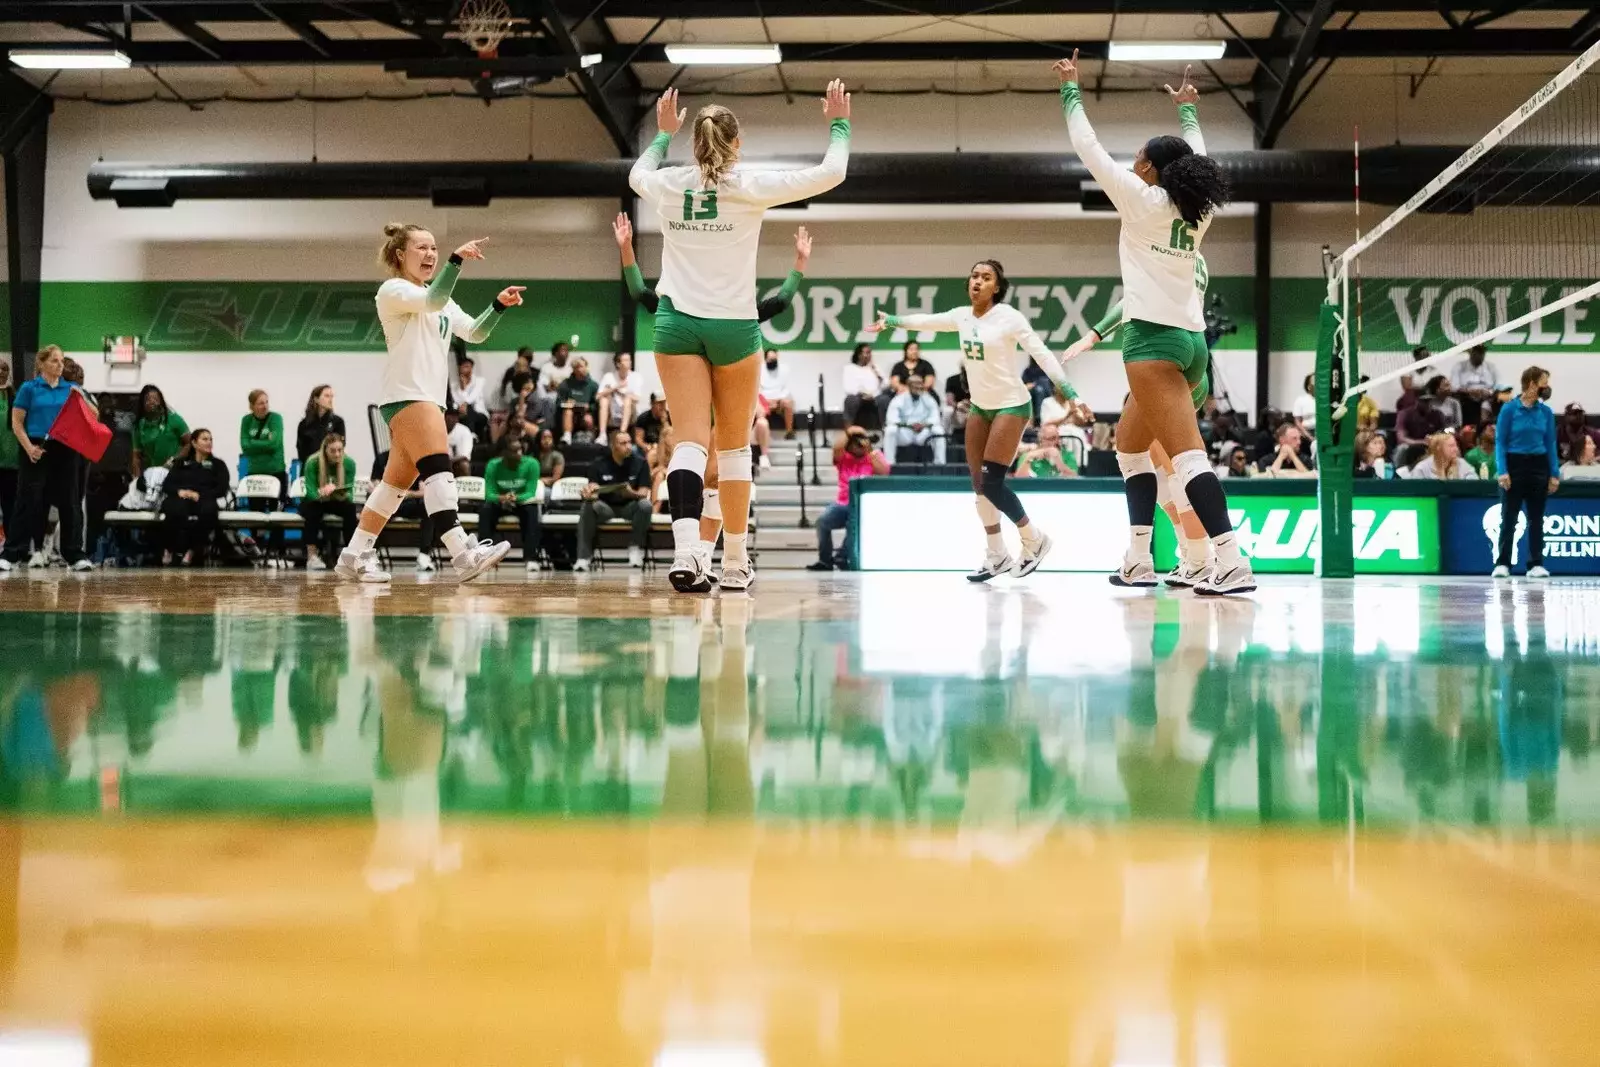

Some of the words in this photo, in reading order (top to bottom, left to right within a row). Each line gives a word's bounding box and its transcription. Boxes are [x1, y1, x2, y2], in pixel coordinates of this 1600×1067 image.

[683, 189, 718, 221] 13
[702, 223, 734, 231] TEXAS
[1170, 218, 1195, 251] 16
[757, 285, 939, 345] ORTH
[1003, 285, 1124, 343] EX
[1388, 286, 1600, 345] VOLLE
[963, 340, 985, 361] 23
